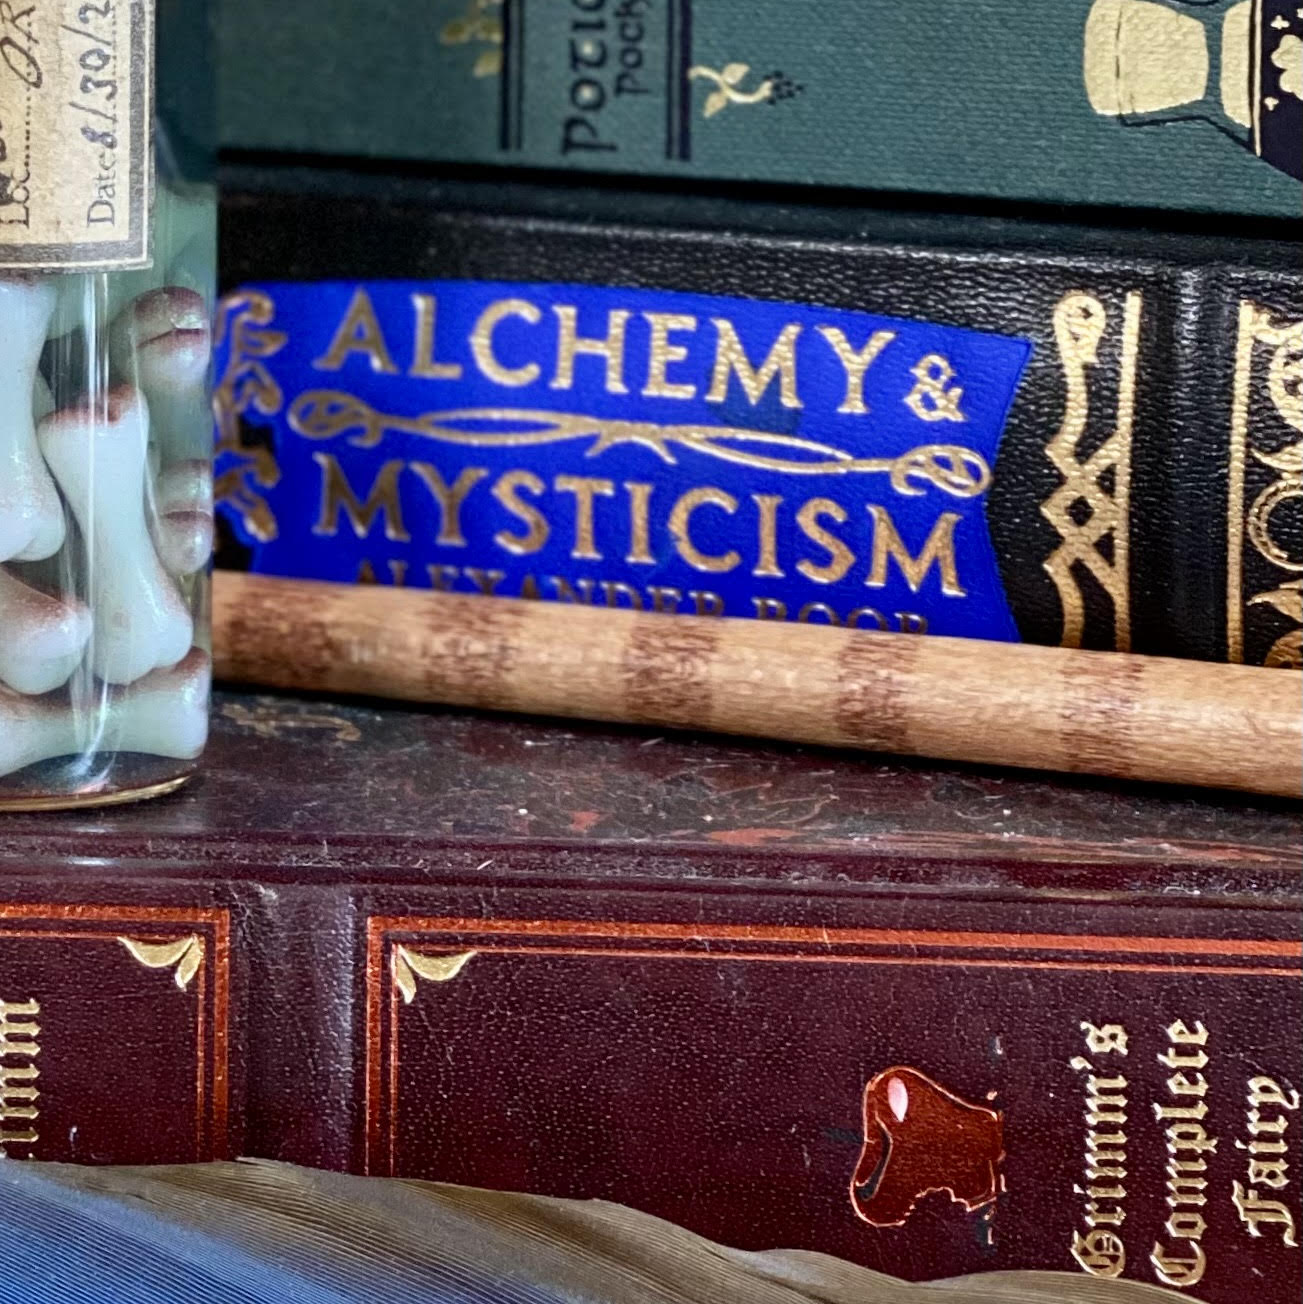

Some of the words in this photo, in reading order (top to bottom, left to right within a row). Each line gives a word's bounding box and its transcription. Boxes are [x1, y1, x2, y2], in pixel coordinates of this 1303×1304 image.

[312, 287, 897, 415] ALCHEMY
[902, 354, 967, 424] &
[312, 452, 967, 598] MYSTICISM
[1070, 1020, 1129, 1278] Grimm's
[1150, 1018, 1218, 1287] Complete
[1231, 1075, 1300, 1247] Fairy
